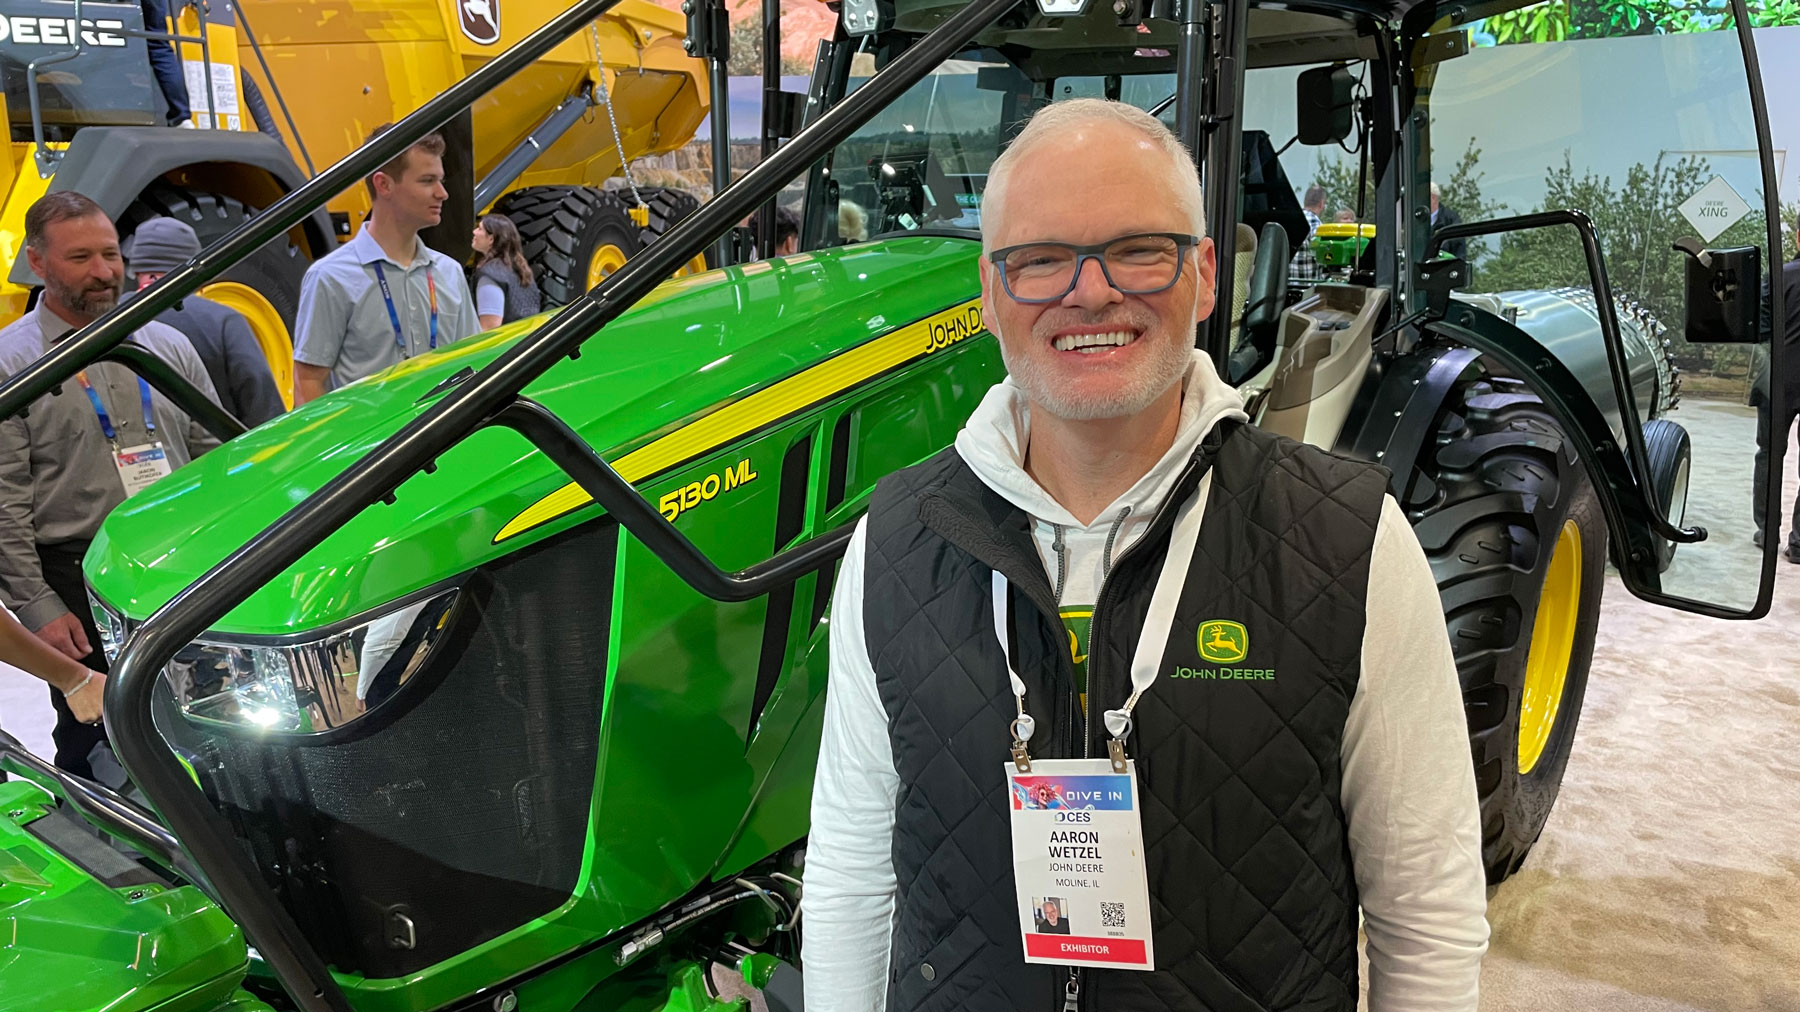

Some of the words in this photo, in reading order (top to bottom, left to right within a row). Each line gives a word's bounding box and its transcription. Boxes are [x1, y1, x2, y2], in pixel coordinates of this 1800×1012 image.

[1698, 206, 1728, 218] XING
[925, 313, 970, 353] JOHN
[658, 472, 722, 524] 5130
[723, 457, 759, 493] ML
[1170, 666, 1216, 680] JOHN
[1219, 667, 1275, 680] DEERE
[1066, 791, 1102, 801] DIVE
[1108, 791, 1122, 801] IN
[1066, 811, 1091, 823] CES
[1050, 831, 1099, 844] AARON
[1048, 846, 1102, 859] WETZEL
[1049, 863, 1073, 872] JOHN
[1075, 863, 1104, 873] DEERE
[1055, 878, 1091, 888] MOLINE,
[1092, 879, 1101, 888] IL
[1060, 942, 1110, 955] EXHIBITOR
